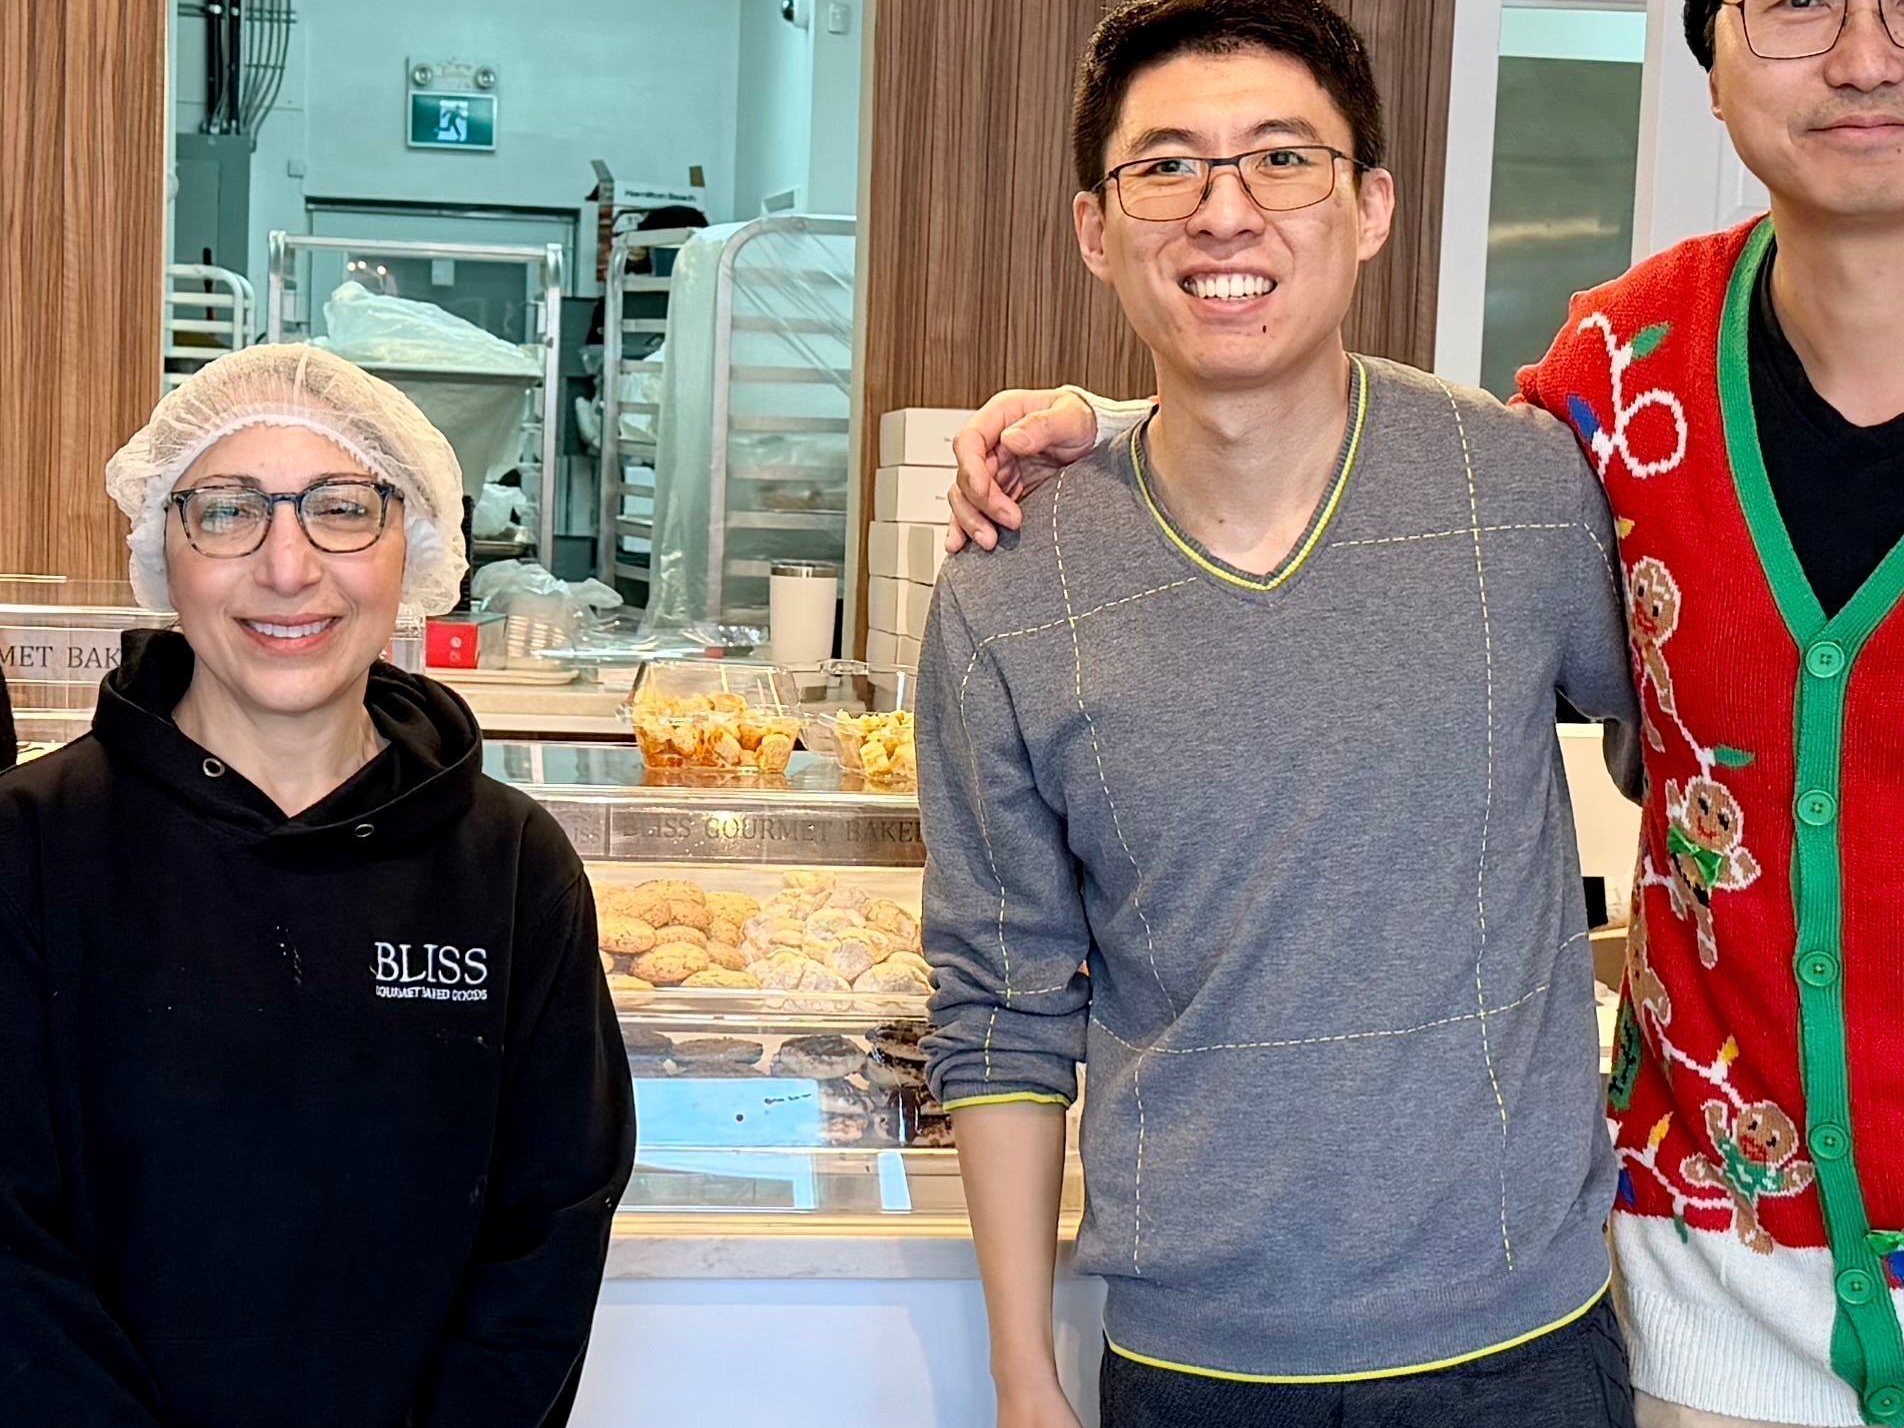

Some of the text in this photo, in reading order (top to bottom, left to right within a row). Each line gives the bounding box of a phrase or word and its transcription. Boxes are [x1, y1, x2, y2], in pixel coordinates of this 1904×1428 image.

[67, 646, 122, 669] BAK
[704, 817, 833, 842] GOURMET
[374, 941, 489, 985] BLISS
[451, 989, 488, 1002] GOODS
